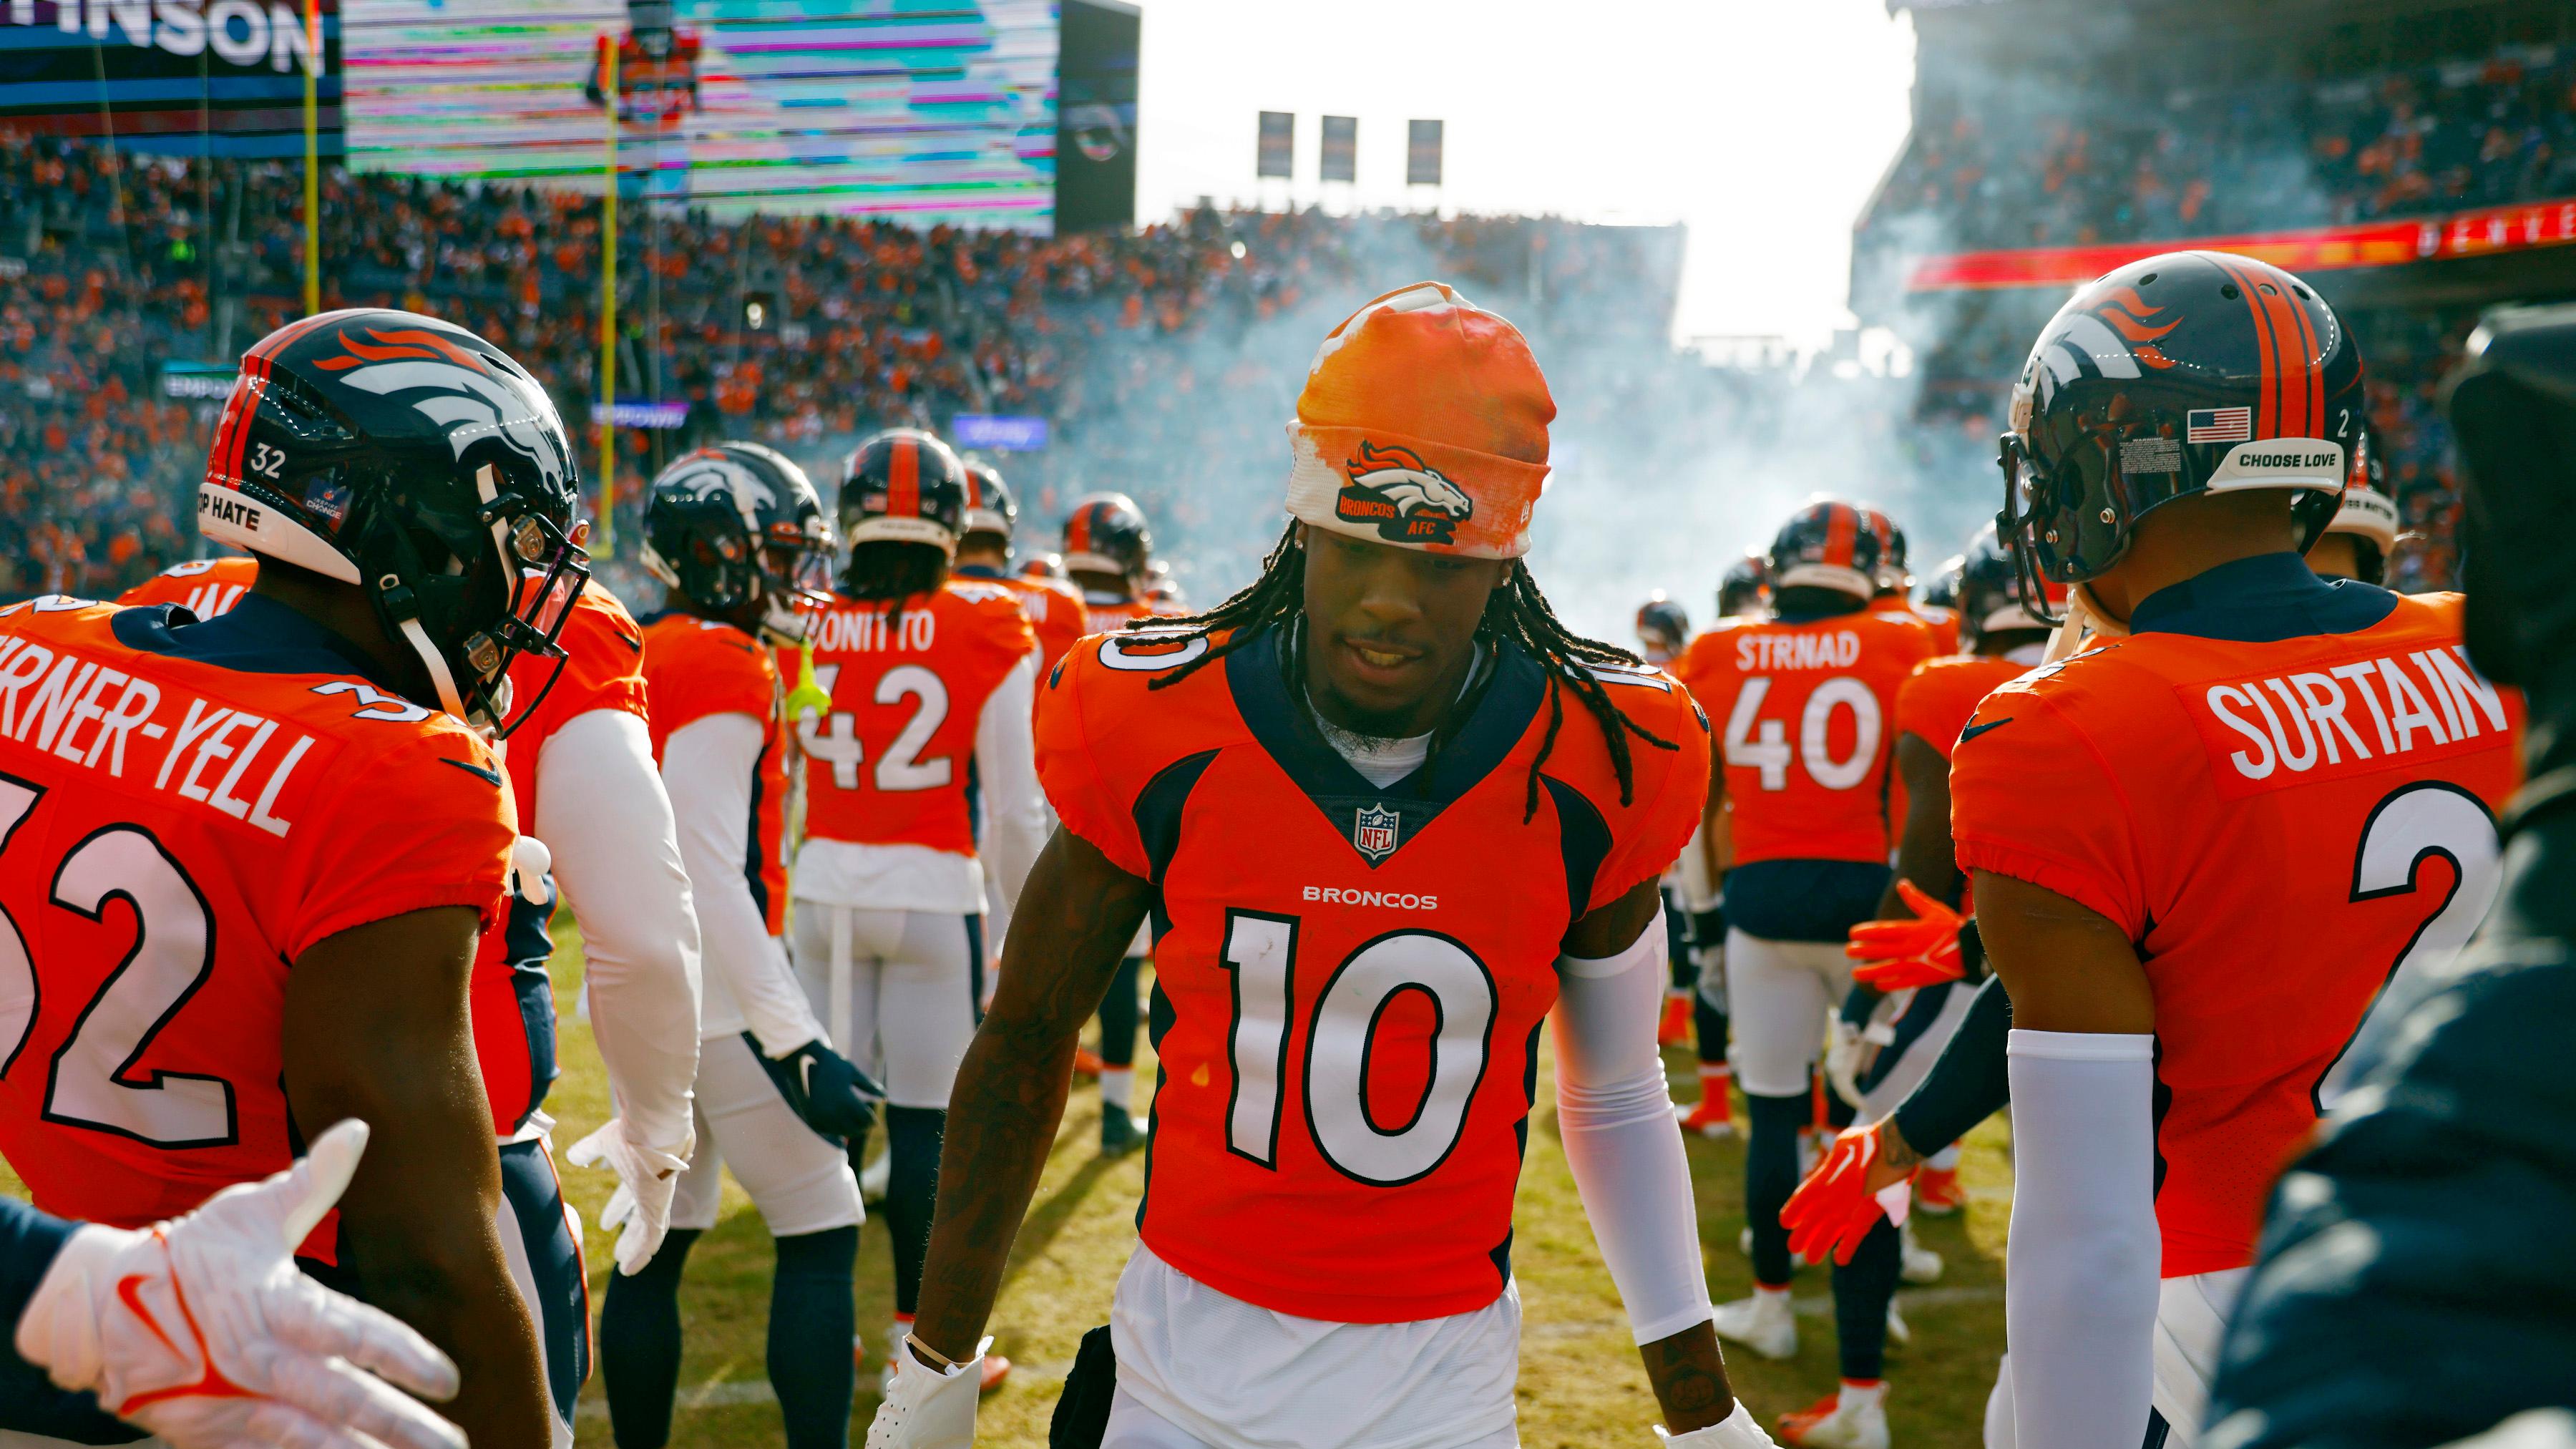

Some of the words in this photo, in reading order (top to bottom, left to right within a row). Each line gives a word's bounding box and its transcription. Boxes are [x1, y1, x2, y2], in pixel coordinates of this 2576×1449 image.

[2338, 409, 2349, 438] 2
[251, 441, 286, 479] 32
[2240, 454, 2301, 467] CHOOSE
[2305, 454, 2336, 467] LOVE
[213, 495, 260, 532] HATE
[306, 500, 342, 519] CHANGE
[1340, 495, 1396, 519] BRONCOS
[1407, 522, 1437, 535] AFC
[1736, 630, 1860, 671] STRNAD
[796, 663, 953, 791] 42
[2207, 645, 2508, 780] SURTAIN
[1724, 676, 1883, 791] 40
[1361, 828, 1391, 850] NFL
[1302, 886, 1438, 910] BRONCOS
[0, 770, 239, 1150] 2
[1218, 906, 1500, 1188] 10
